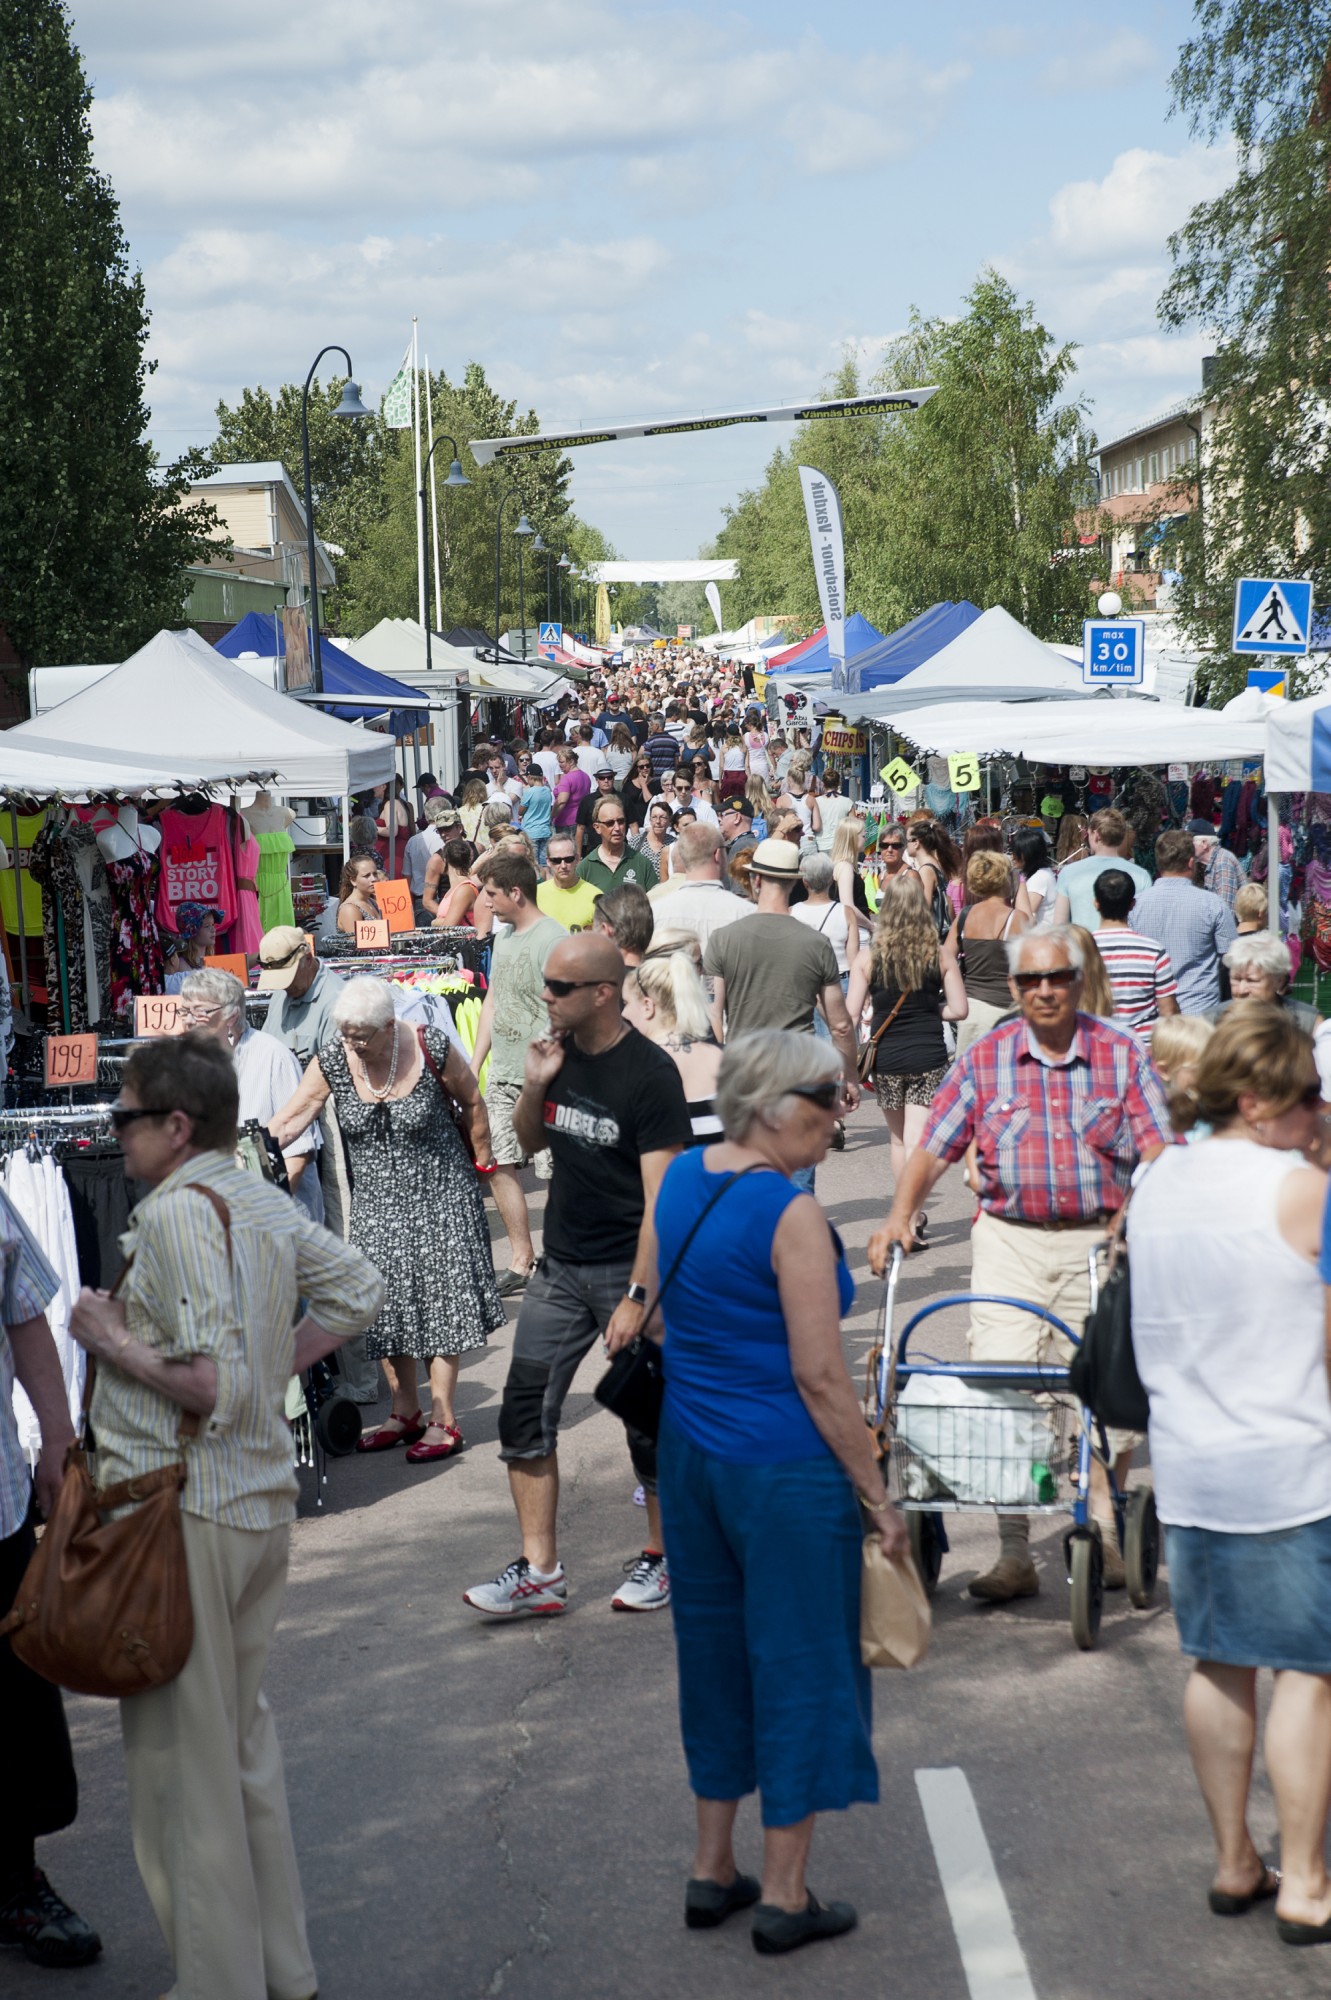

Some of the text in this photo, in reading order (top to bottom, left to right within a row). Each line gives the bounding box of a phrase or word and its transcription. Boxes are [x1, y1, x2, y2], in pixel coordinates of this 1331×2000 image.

[1102, 631, 1125, 640] max
[1097, 643, 1128, 661] 30
[1093, 663, 1132, 673] km/tim
[824, 731, 855, 749] CHIPS
[167, 866, 218, 882] STORY
[167, 879, 219, 901] BRO
